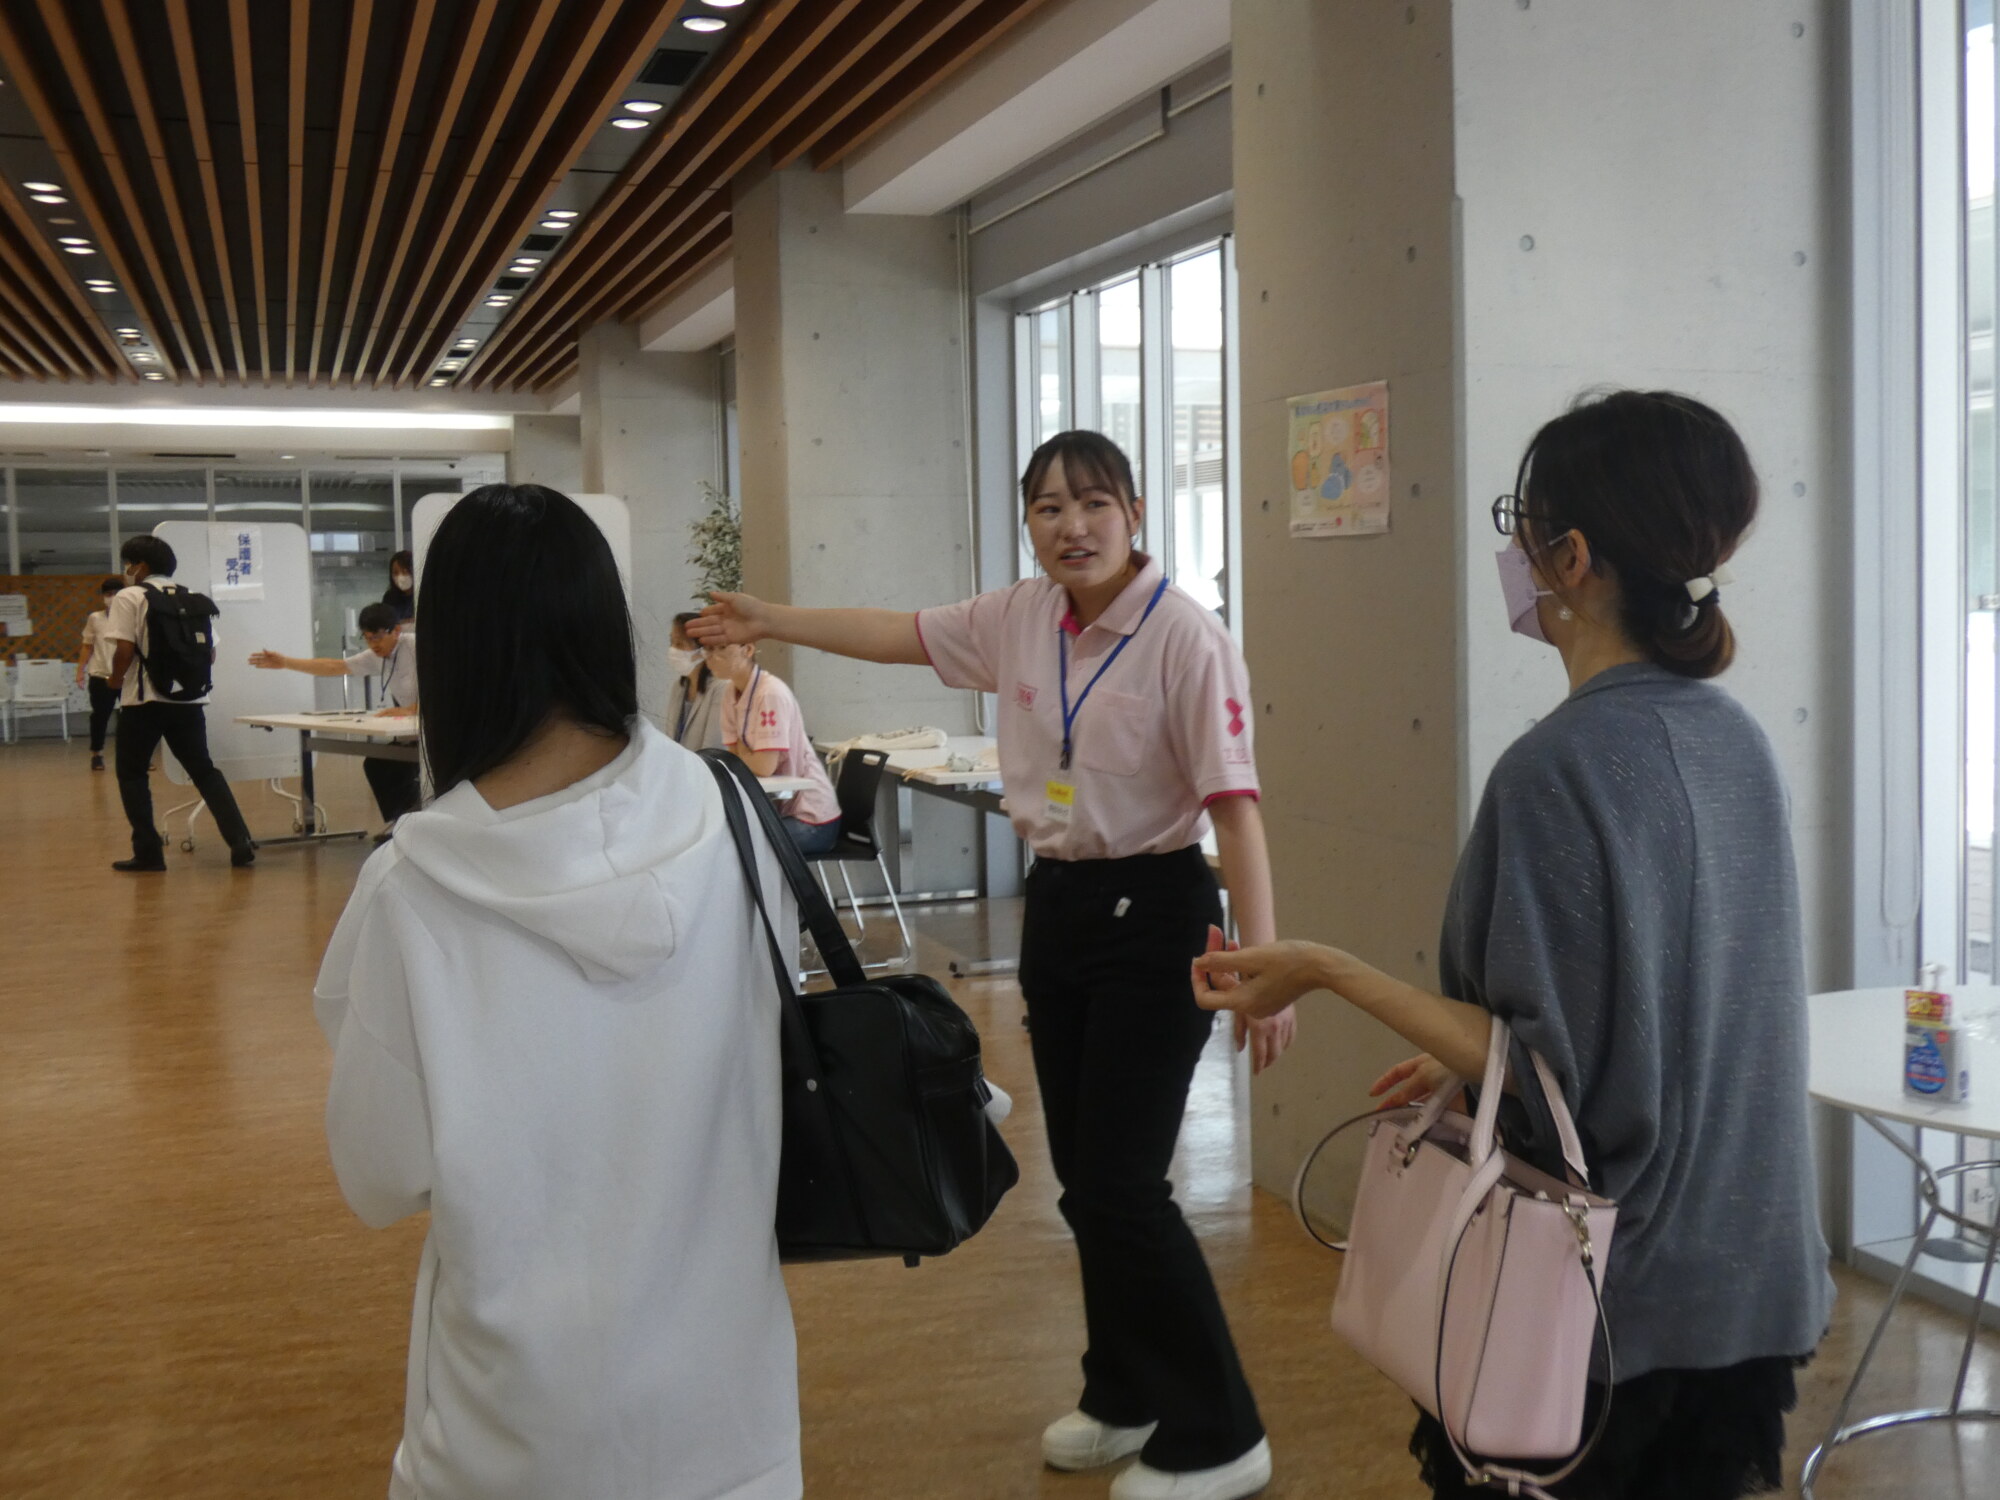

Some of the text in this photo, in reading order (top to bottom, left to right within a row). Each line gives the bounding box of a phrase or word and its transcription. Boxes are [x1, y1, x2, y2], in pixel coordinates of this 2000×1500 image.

[226, 558, 239, 584] 受付
[238, 533, 251, 575] 保護者
